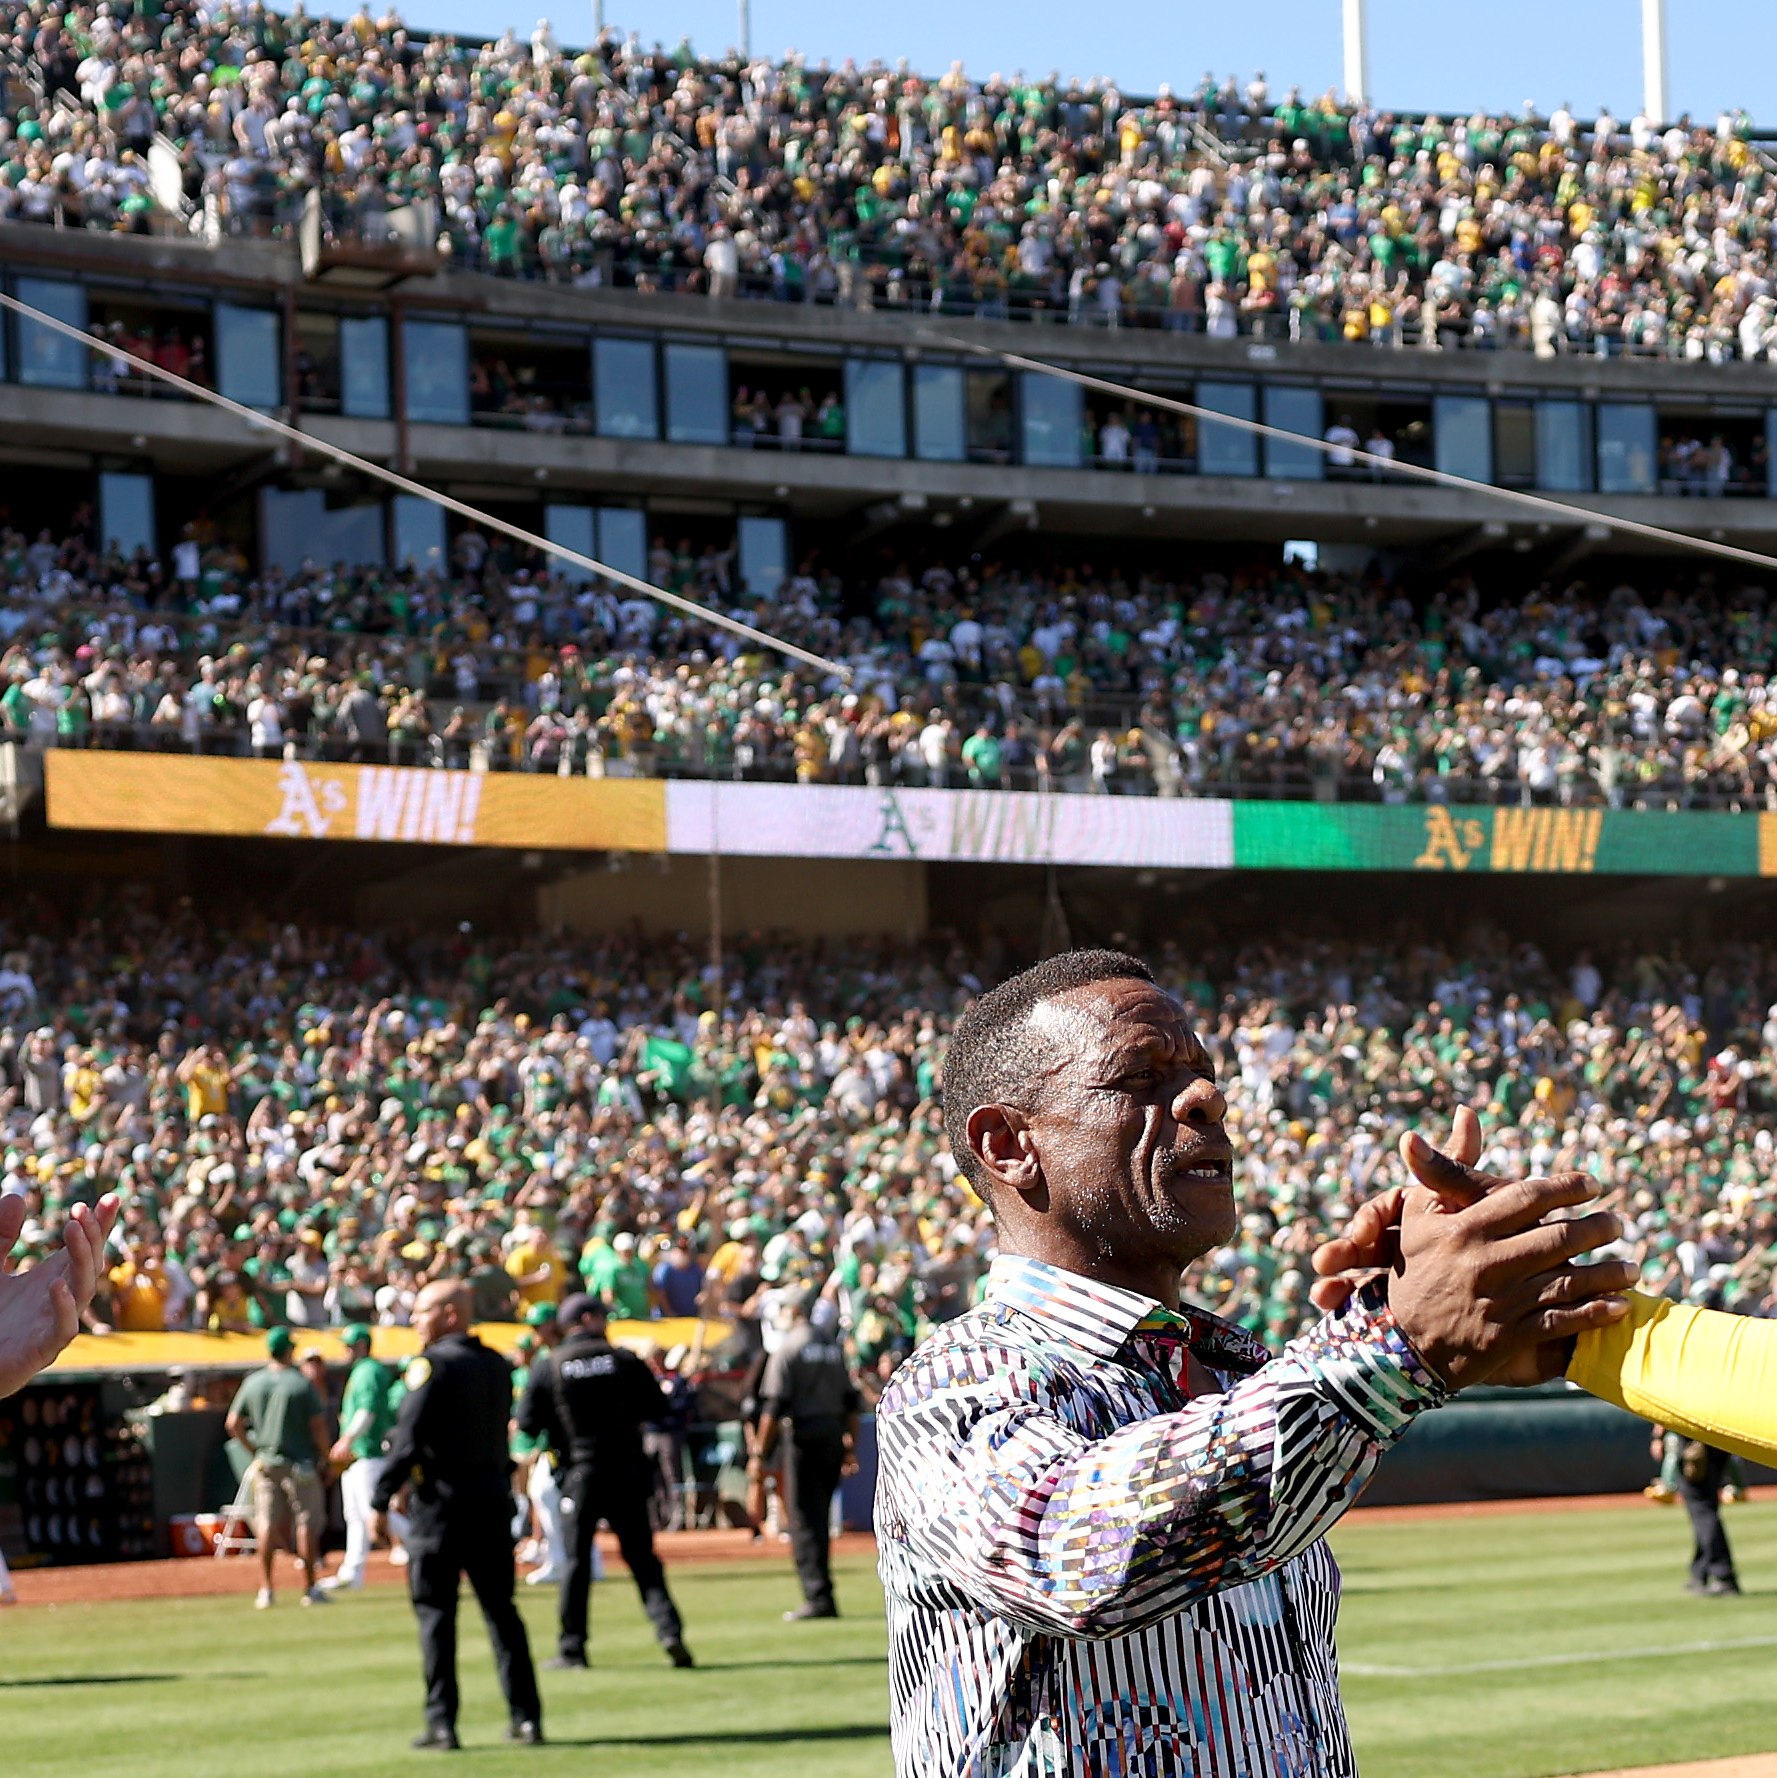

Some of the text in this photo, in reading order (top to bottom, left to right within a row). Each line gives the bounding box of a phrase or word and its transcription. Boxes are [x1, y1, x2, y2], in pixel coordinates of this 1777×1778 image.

[264, 760, 482, 844] A's WIN!
[870, 787, 1065, 857] A's WIN!
[1413, 804, 1604, 872] A's WIN!
[561, 1354, 615, 1379] POLICE
